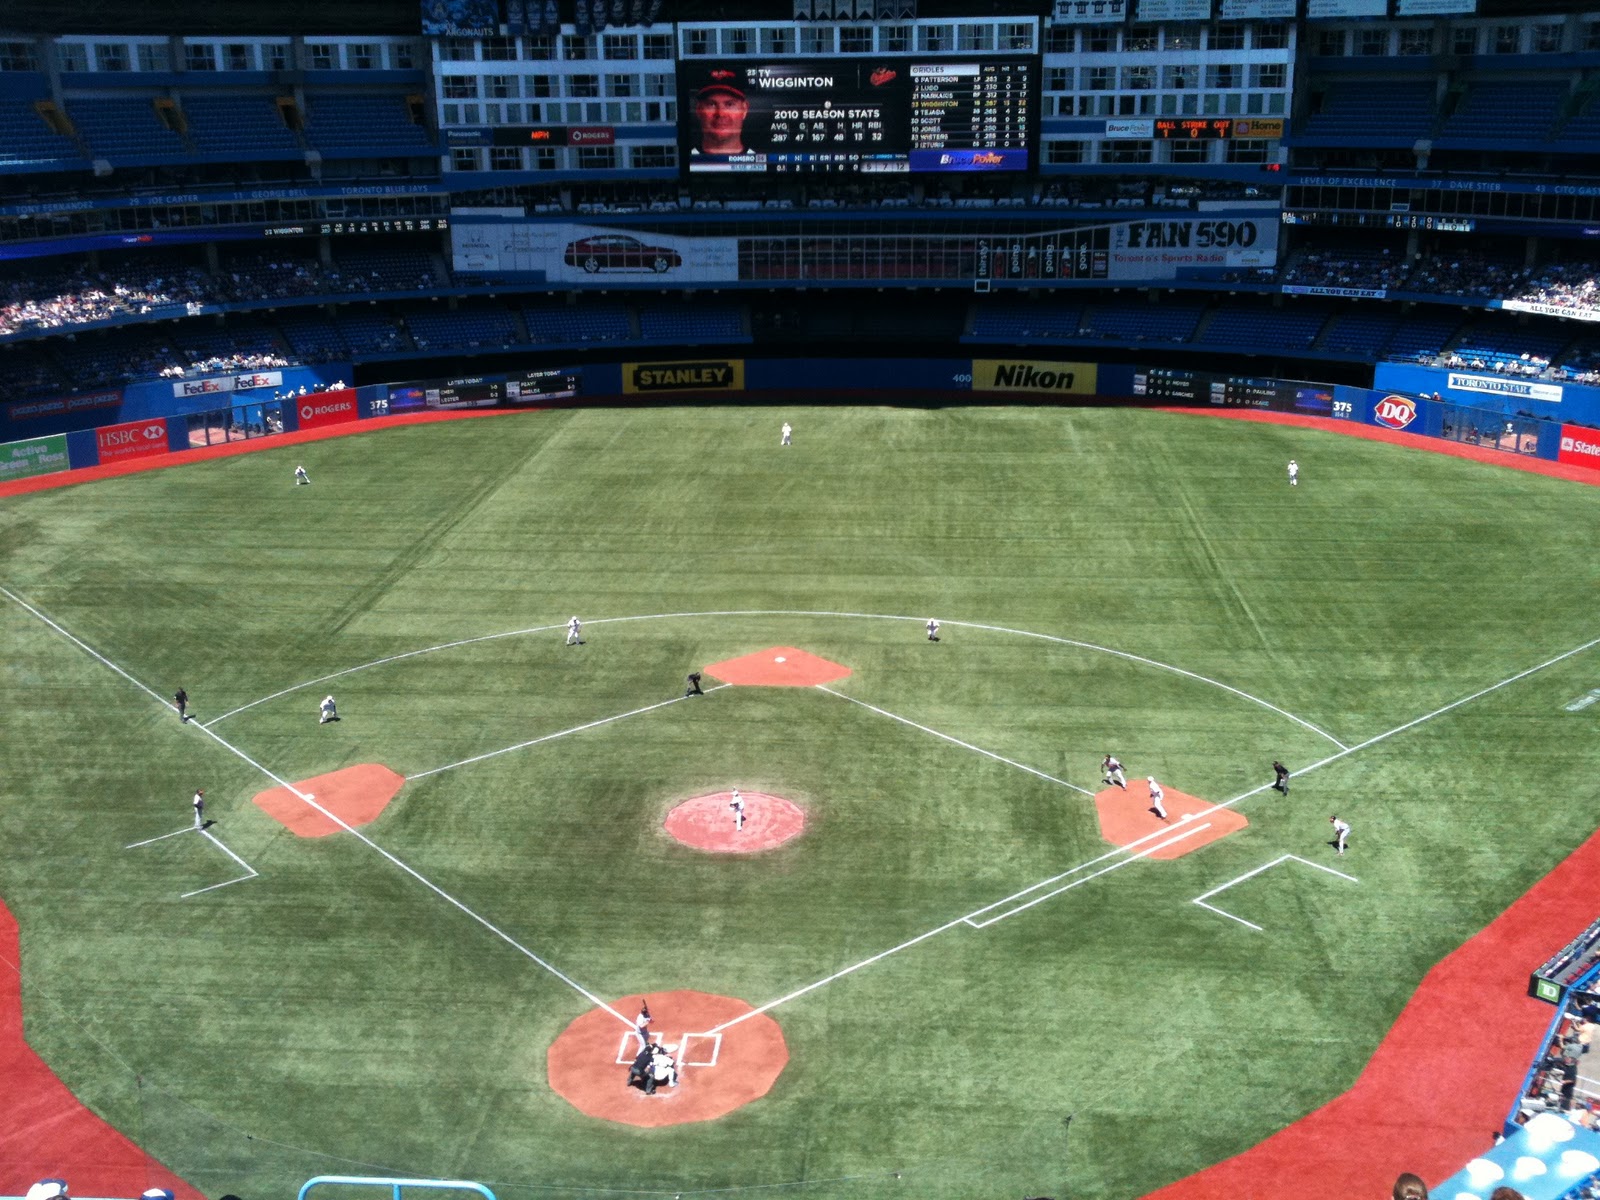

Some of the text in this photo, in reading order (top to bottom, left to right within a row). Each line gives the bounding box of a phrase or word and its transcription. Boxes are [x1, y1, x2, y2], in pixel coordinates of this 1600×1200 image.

[446, 28, 494, 36] ARGONAUTS
[759, 77, 833, 88] WIGGINTON
[774, 109, 880, 119] 2010 SEASON STATS
[1252, 121, 1281, 129] Home
[531, 131, 549, 140] MPH
[1163, 129, 1225, 138] 1 0 1
[1342, 178, 1397, 186] EXCELLENCE
[1476, 182, 1501, 190] STIEB
[341, 187, 382, 195] TORONTO
[1554, 186, 1575, 194] CITO
[166, 194, 198, 204] CARTER
[16, 201, 94, 214] TONY FERNANDEZ
[1116, 225, 1124, 249] THE
[1128, 221, 1256, 248] FAN 590
[979, 240, 988, 276] thirsty?
[1162, 254, 1193, 263] Sports
[640, 368, 726, 385] STANLEY
[953, 374, 972, 382] 400
[994, 365, 1075, 389] Nikon
[184, 381, 219, 395] FedEx
[235, 376, 269, 389] FedEx
[1456, 378, 1527, 394] TORONTO STAR
[315, 402, 352, 415] ROGERS
[370, 400, 388, 410] 375
[1333, 401, 1352, 412] 375
[1382, 402, 1409, 424] DQ
[100, 429, 139, 447] HSBC
[12, 445, 47, 457] Active
[1574, 441, 1600, 456] State
[39, 452, 64, 463] Ross
[1541, 984, 1556, 997] TD
